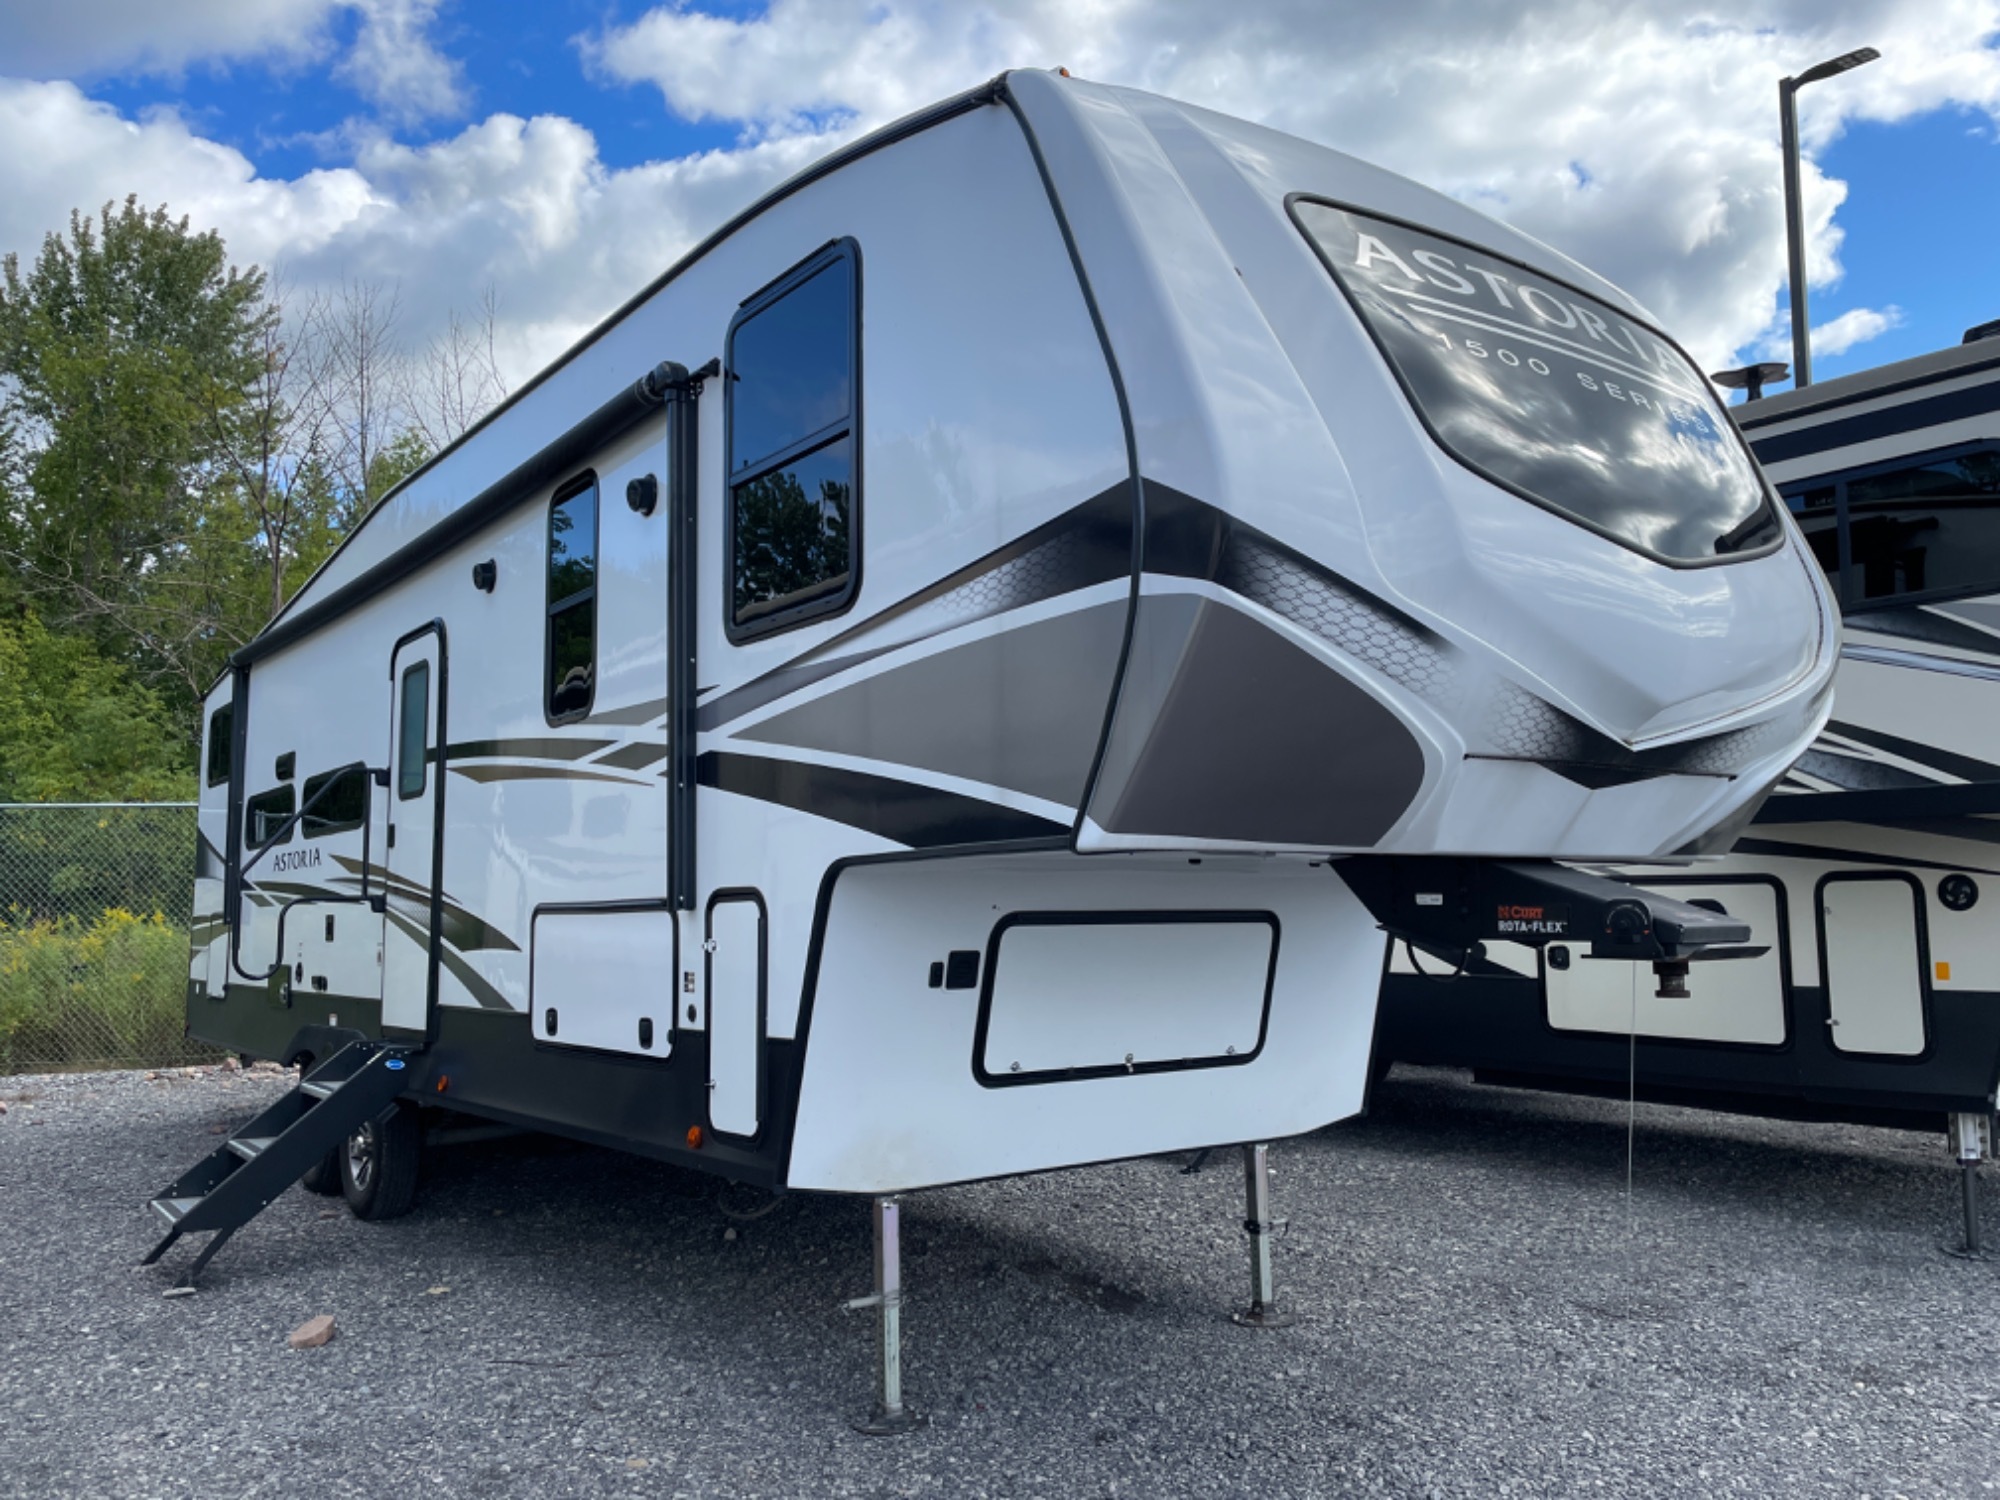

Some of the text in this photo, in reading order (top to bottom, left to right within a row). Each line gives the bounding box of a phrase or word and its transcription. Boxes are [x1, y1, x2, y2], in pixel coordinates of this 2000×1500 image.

[1355, 232, 1702, 391] ASTORIA
[1438, 333, 1710, 433] 1500 SERIES
[273, 848, 322, 872] ASTORIA
[1511, 905, 1544, 919] CURT
[1498, 920, 1562, 934] ROTA-FLEX
